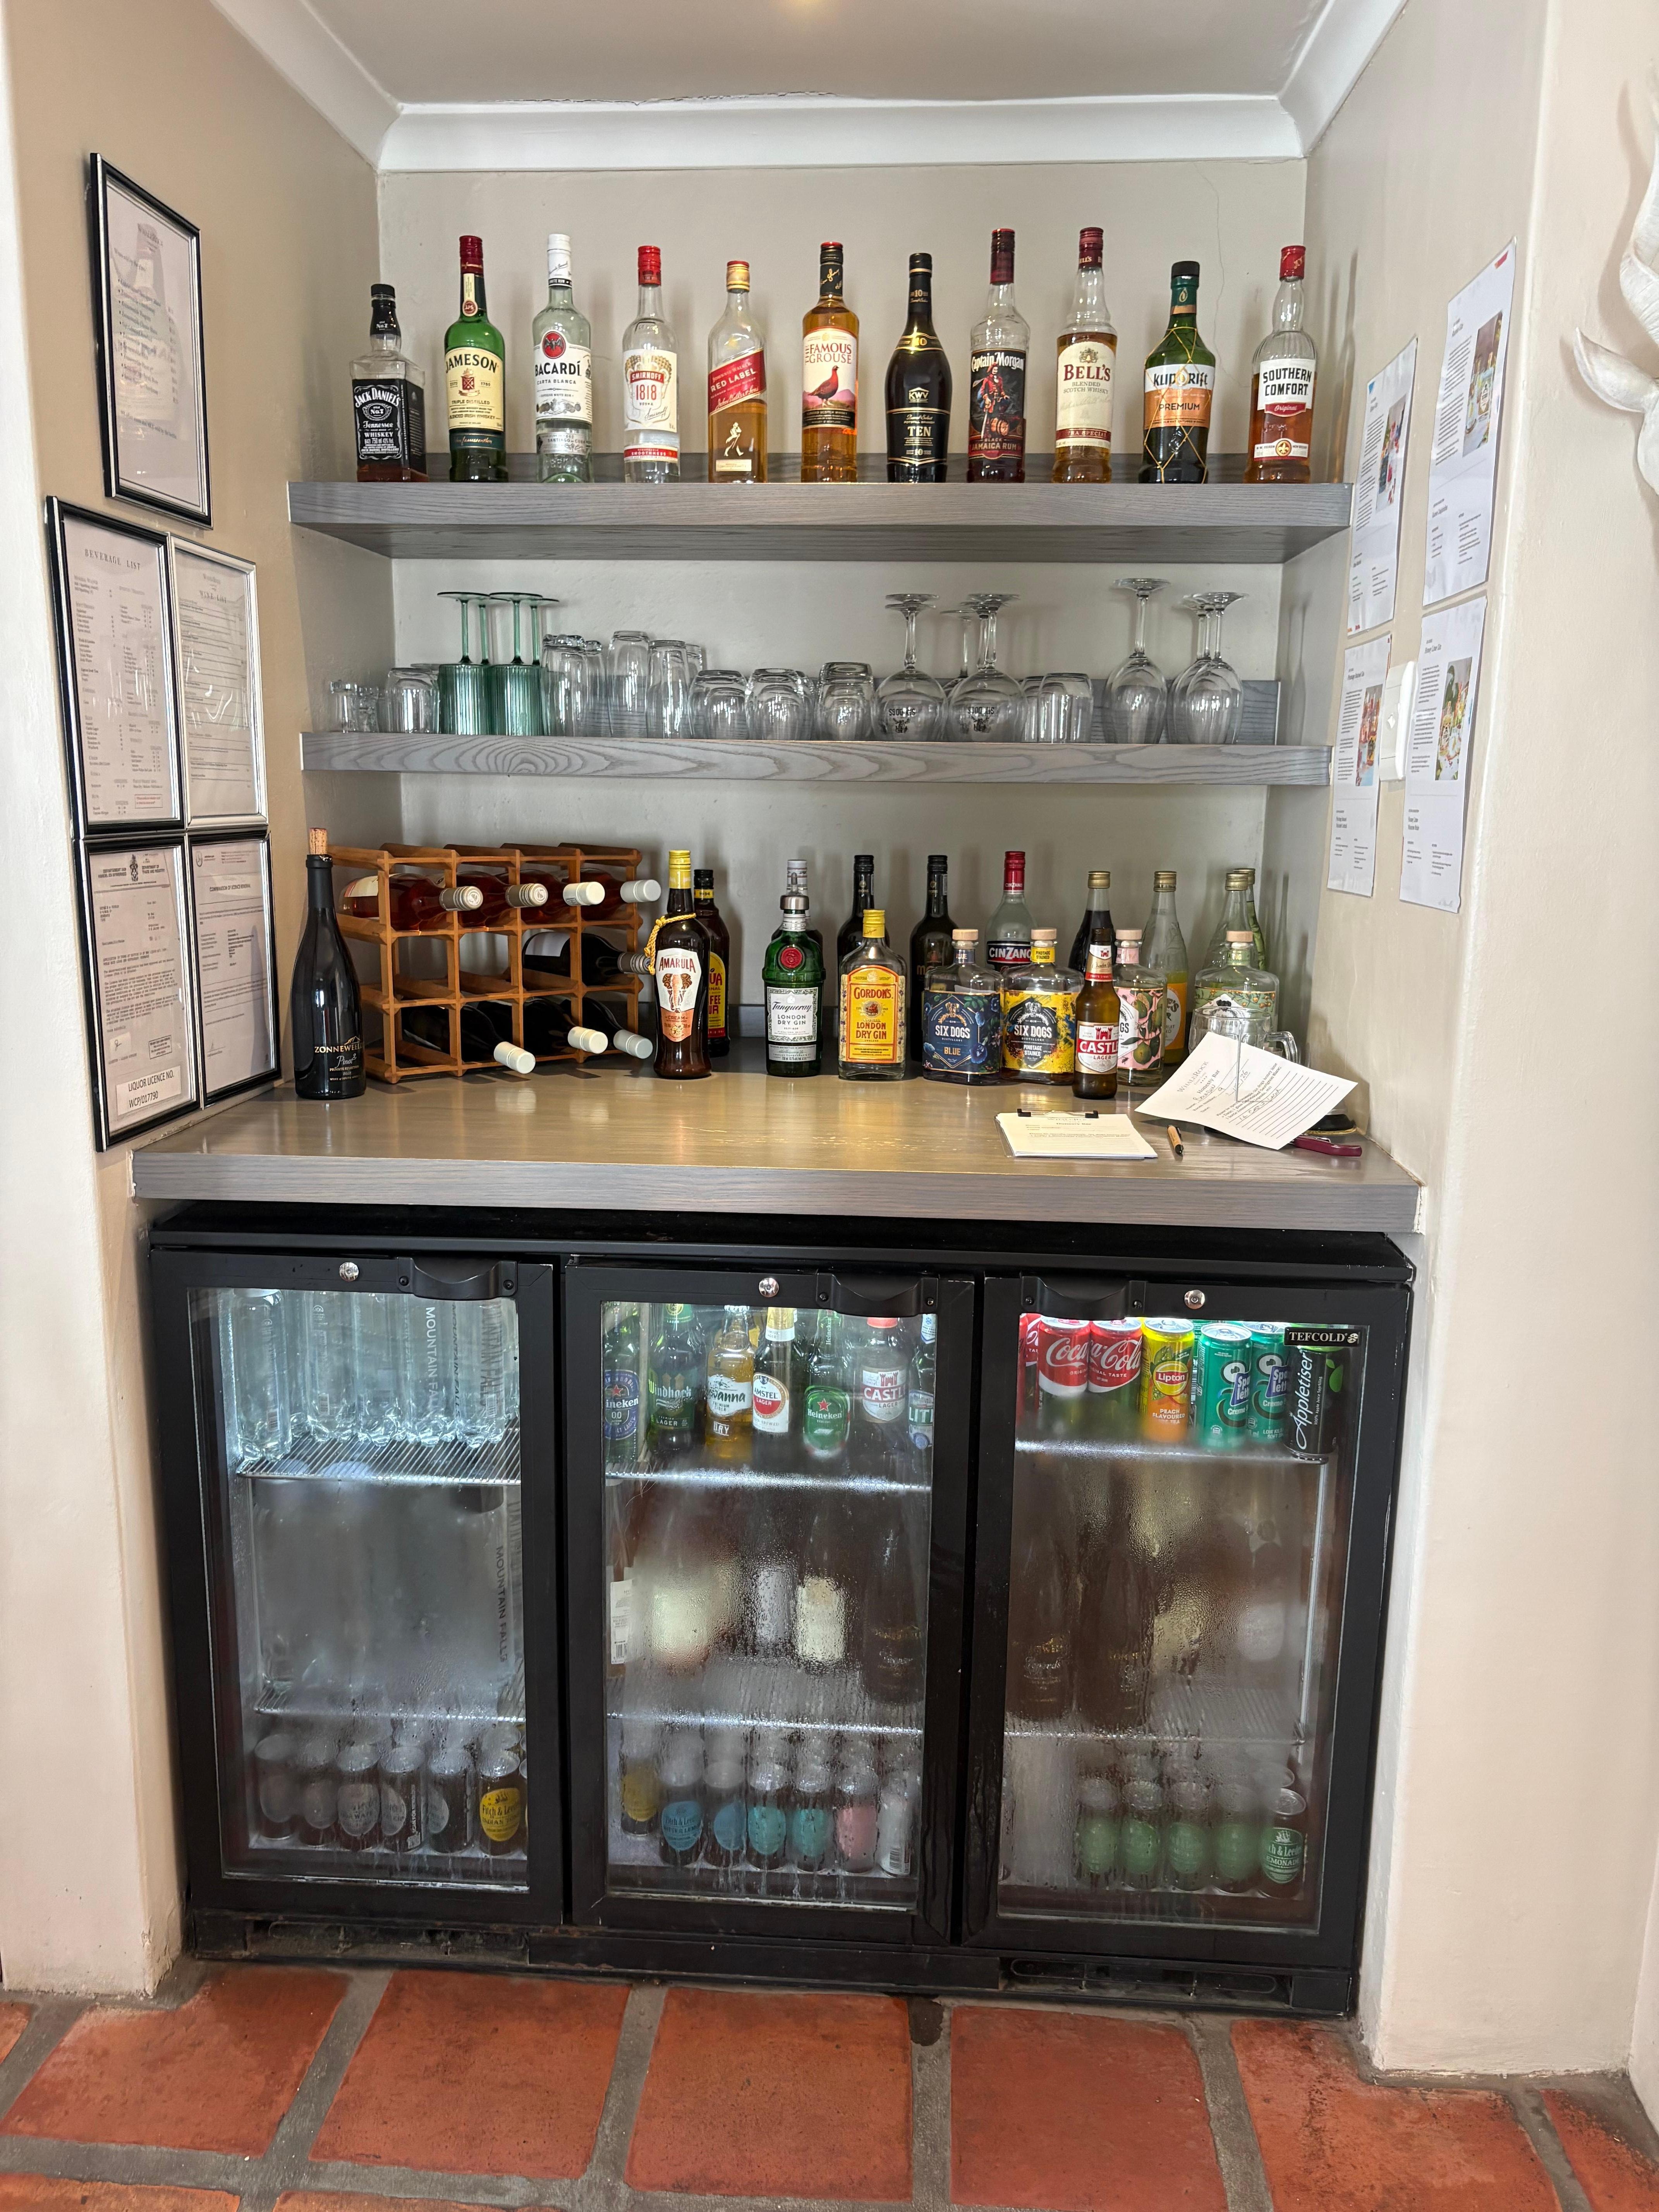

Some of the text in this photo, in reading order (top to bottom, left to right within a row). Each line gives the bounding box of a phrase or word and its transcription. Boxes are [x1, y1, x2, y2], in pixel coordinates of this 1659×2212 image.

[810, 343, 852, 354] FAMOUS
[446, 354, 497, 373] JAMESON
[809, 353, 852, 364] GROUSE
[972, 352, 1024, 372] Captain Morgan
[535, 361, 580, 376] BACARDÍ
[1063, 364, 1110, 381] BELL'S
[711, 368, 756, 392] RED LABEL
[1263, 368, 1312, 383] SOUTHERN
[636, 385, 656, 400] 1818
[1265, 383, 1308, 396] COMFORT
[354, 388, 400, 408] JACK DANIEL'S
[1159, 403, 1200, 411] PREMIUM
[907, 426, 931, 436] TEN
[85, 548, 141, 571] BEVERAGE LIST
[989, 947, 1031, 960] CINZANO
[659, 957, 696, 973] AMARULA
[854, 987, 891, 999] GORDON'S
[710, 995, 721, 1005] FEE
[772, 1001, 812, 1012] Tanqueray
[935, 1025, 970, 1039] SIX DOGS
[1014, 1025, 1052, 1038] SIX DOGS
[1120, 1022, 1129, 1033] GS
[856, 1030, 886, 1039] DRY GIN
[944, 1047, 961, 1056] BLUE
[128, 1070, 174, 1092] LIQUOR LICENCE NO.
[1197, 1079, 1214, 1094] Honesty
[129, 1091, 158, 1108] WCP/017790
[1290, 1332, 1345, 1341] TEFCOLD
[426, 1307, 437, 1383] MOUNTAIN
[1158, 1373, 1185, 1382] Lipton
[1238, 1376, 1250, 1386] Spa
[1274, 1370, 1287, 1381] Spa
[708, 1390, 745, 1403] vanna
[754, 1388, 778, 1399] AMSTEL
[606, 1397, 639, 1408] ineken
[1293, 1352, 1313, 1449] Appletiser
[807, 1409, 842, 1419] Heineken
[496, 1547, 508, 1662] MOUNTAIN FALLS
[483, 1805, 496, 1817] Fitch
